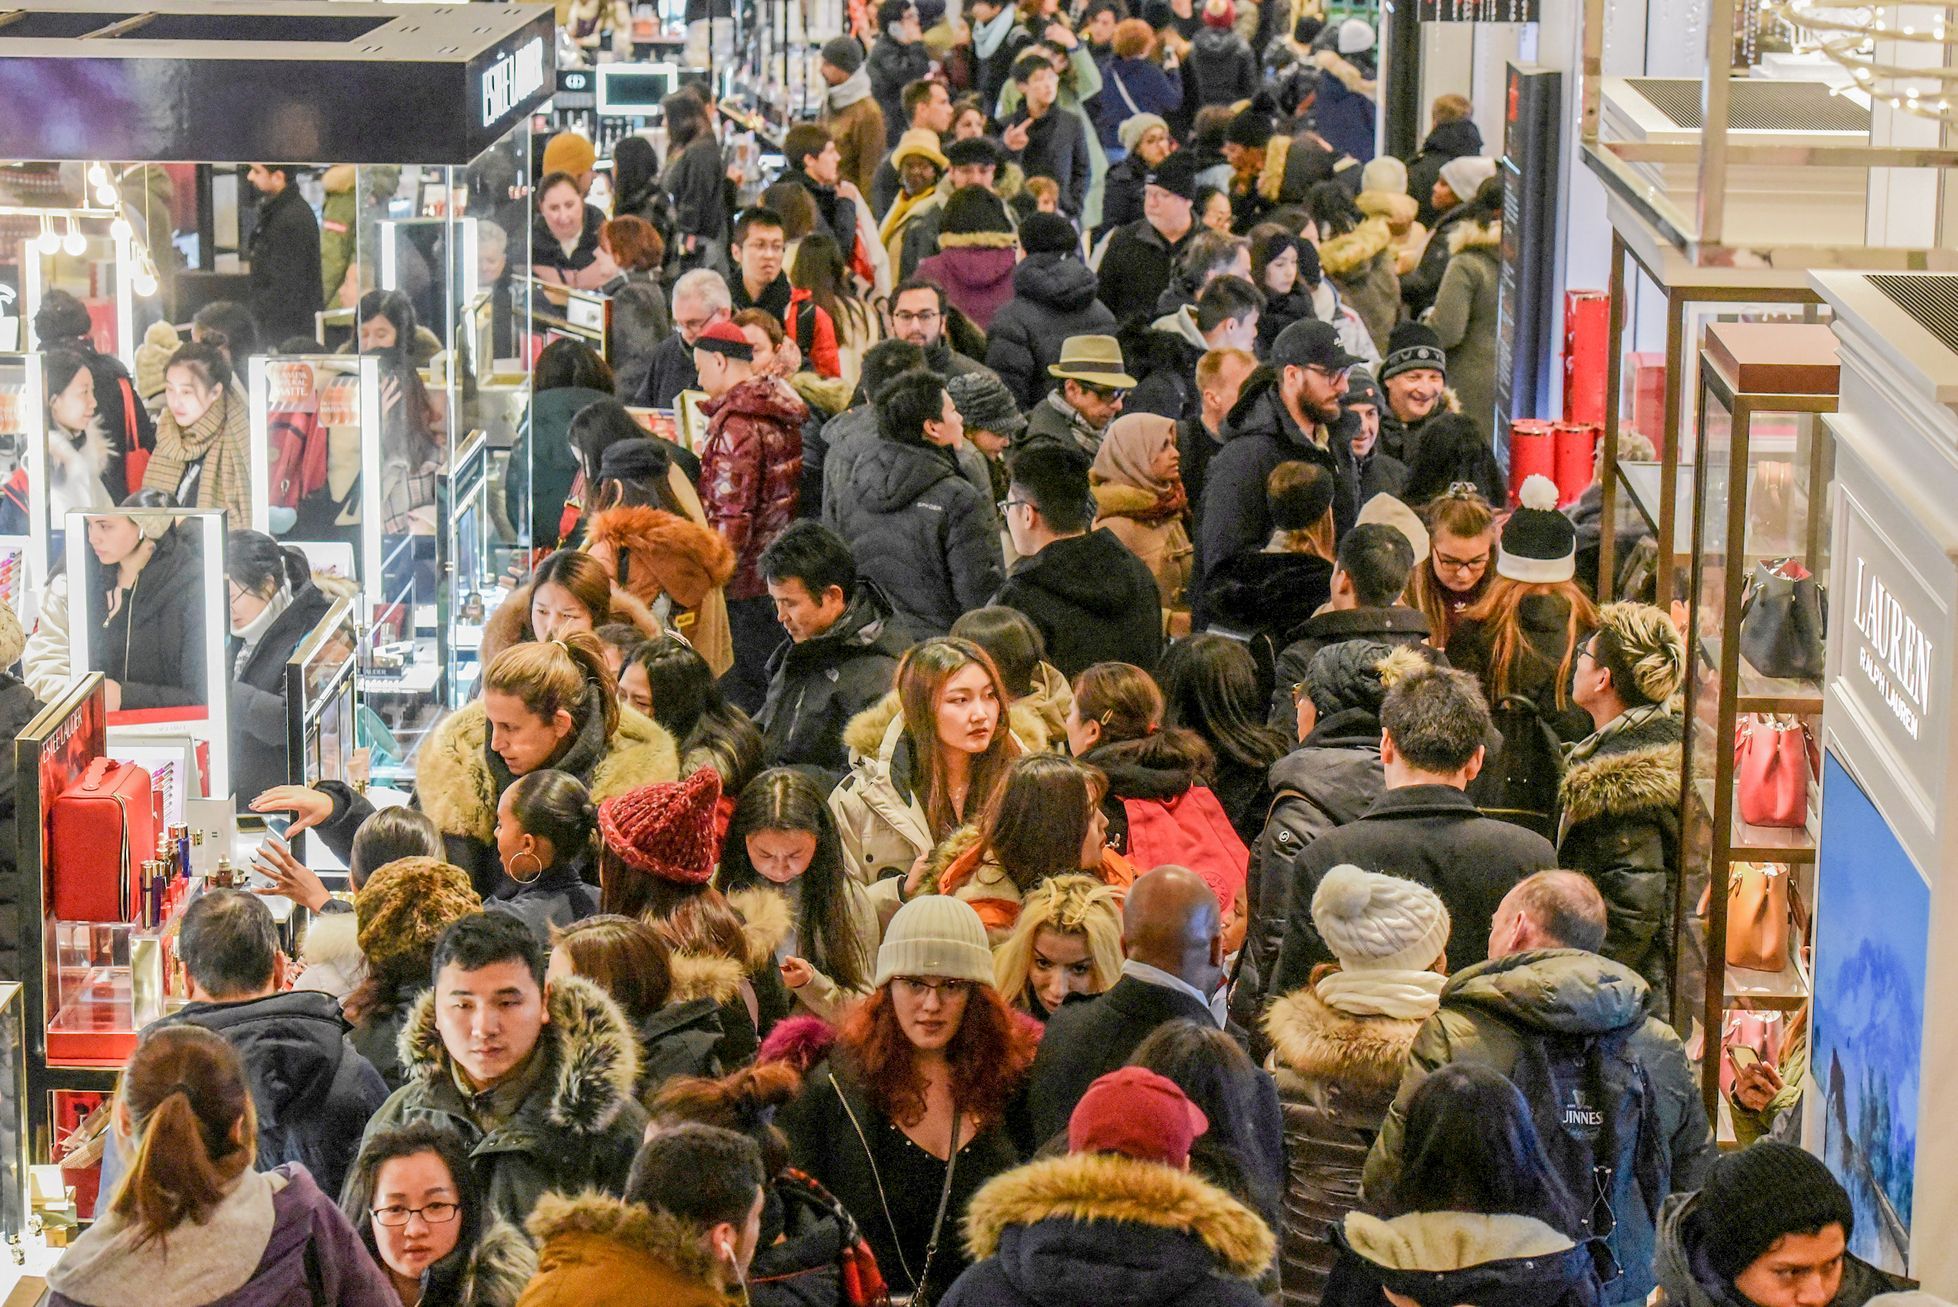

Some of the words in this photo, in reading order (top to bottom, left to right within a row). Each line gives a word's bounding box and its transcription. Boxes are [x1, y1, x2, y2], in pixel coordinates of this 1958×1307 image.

[1854, 556, 1933, 716] LAUREN
[60, 705, 83, 746] LAUDER
[1859, 646, 1885, 696] RALPH
[1885, 681, 1919, 741] LAUREN
